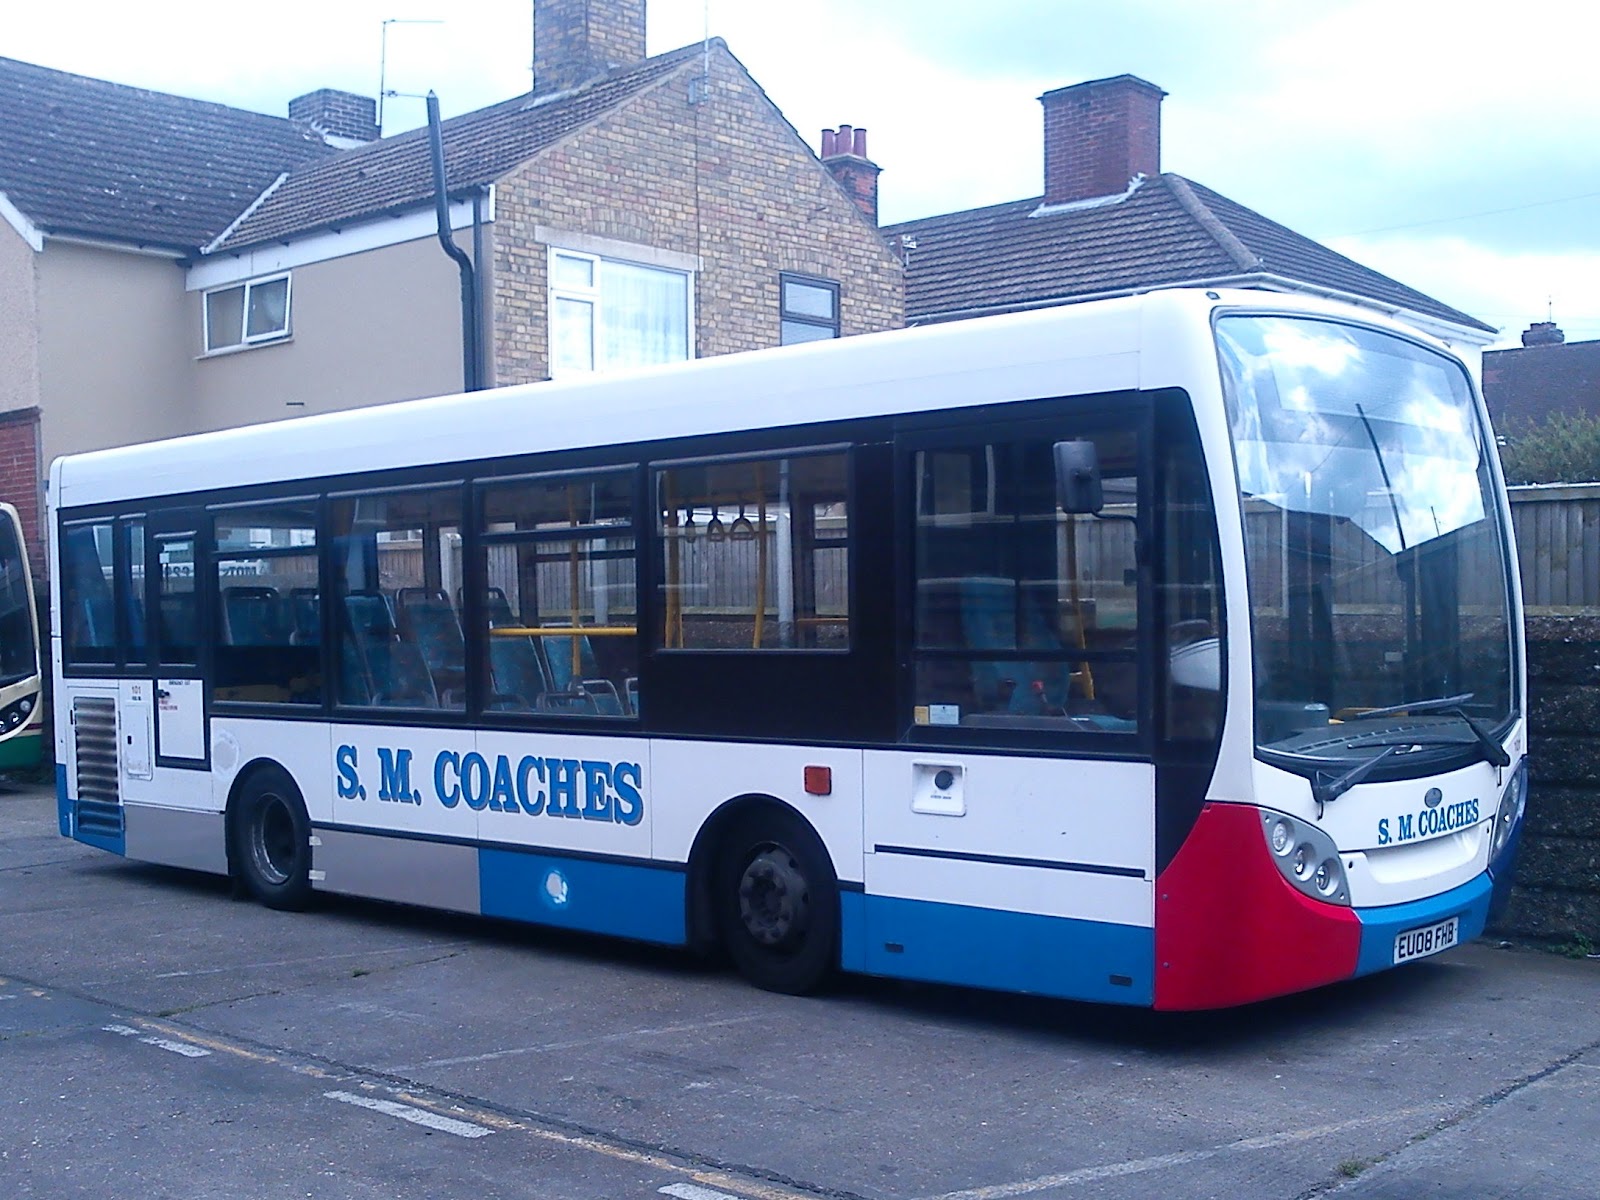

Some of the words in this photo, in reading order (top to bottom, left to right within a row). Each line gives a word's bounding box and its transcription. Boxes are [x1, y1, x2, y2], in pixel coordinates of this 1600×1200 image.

[336, 744, 366, 801] S.
[377, 747, 422, 806] M.
[434, 750, 644, 826] COACHES
[1378, 818, 1392, 845] S.
[1398, 814, 1416, 841] M.
[1418, 798, 1479, 837] COACHES
[1398, 928, 1433, 959] EU08
[1434, 921, 1454, 950] FHB
